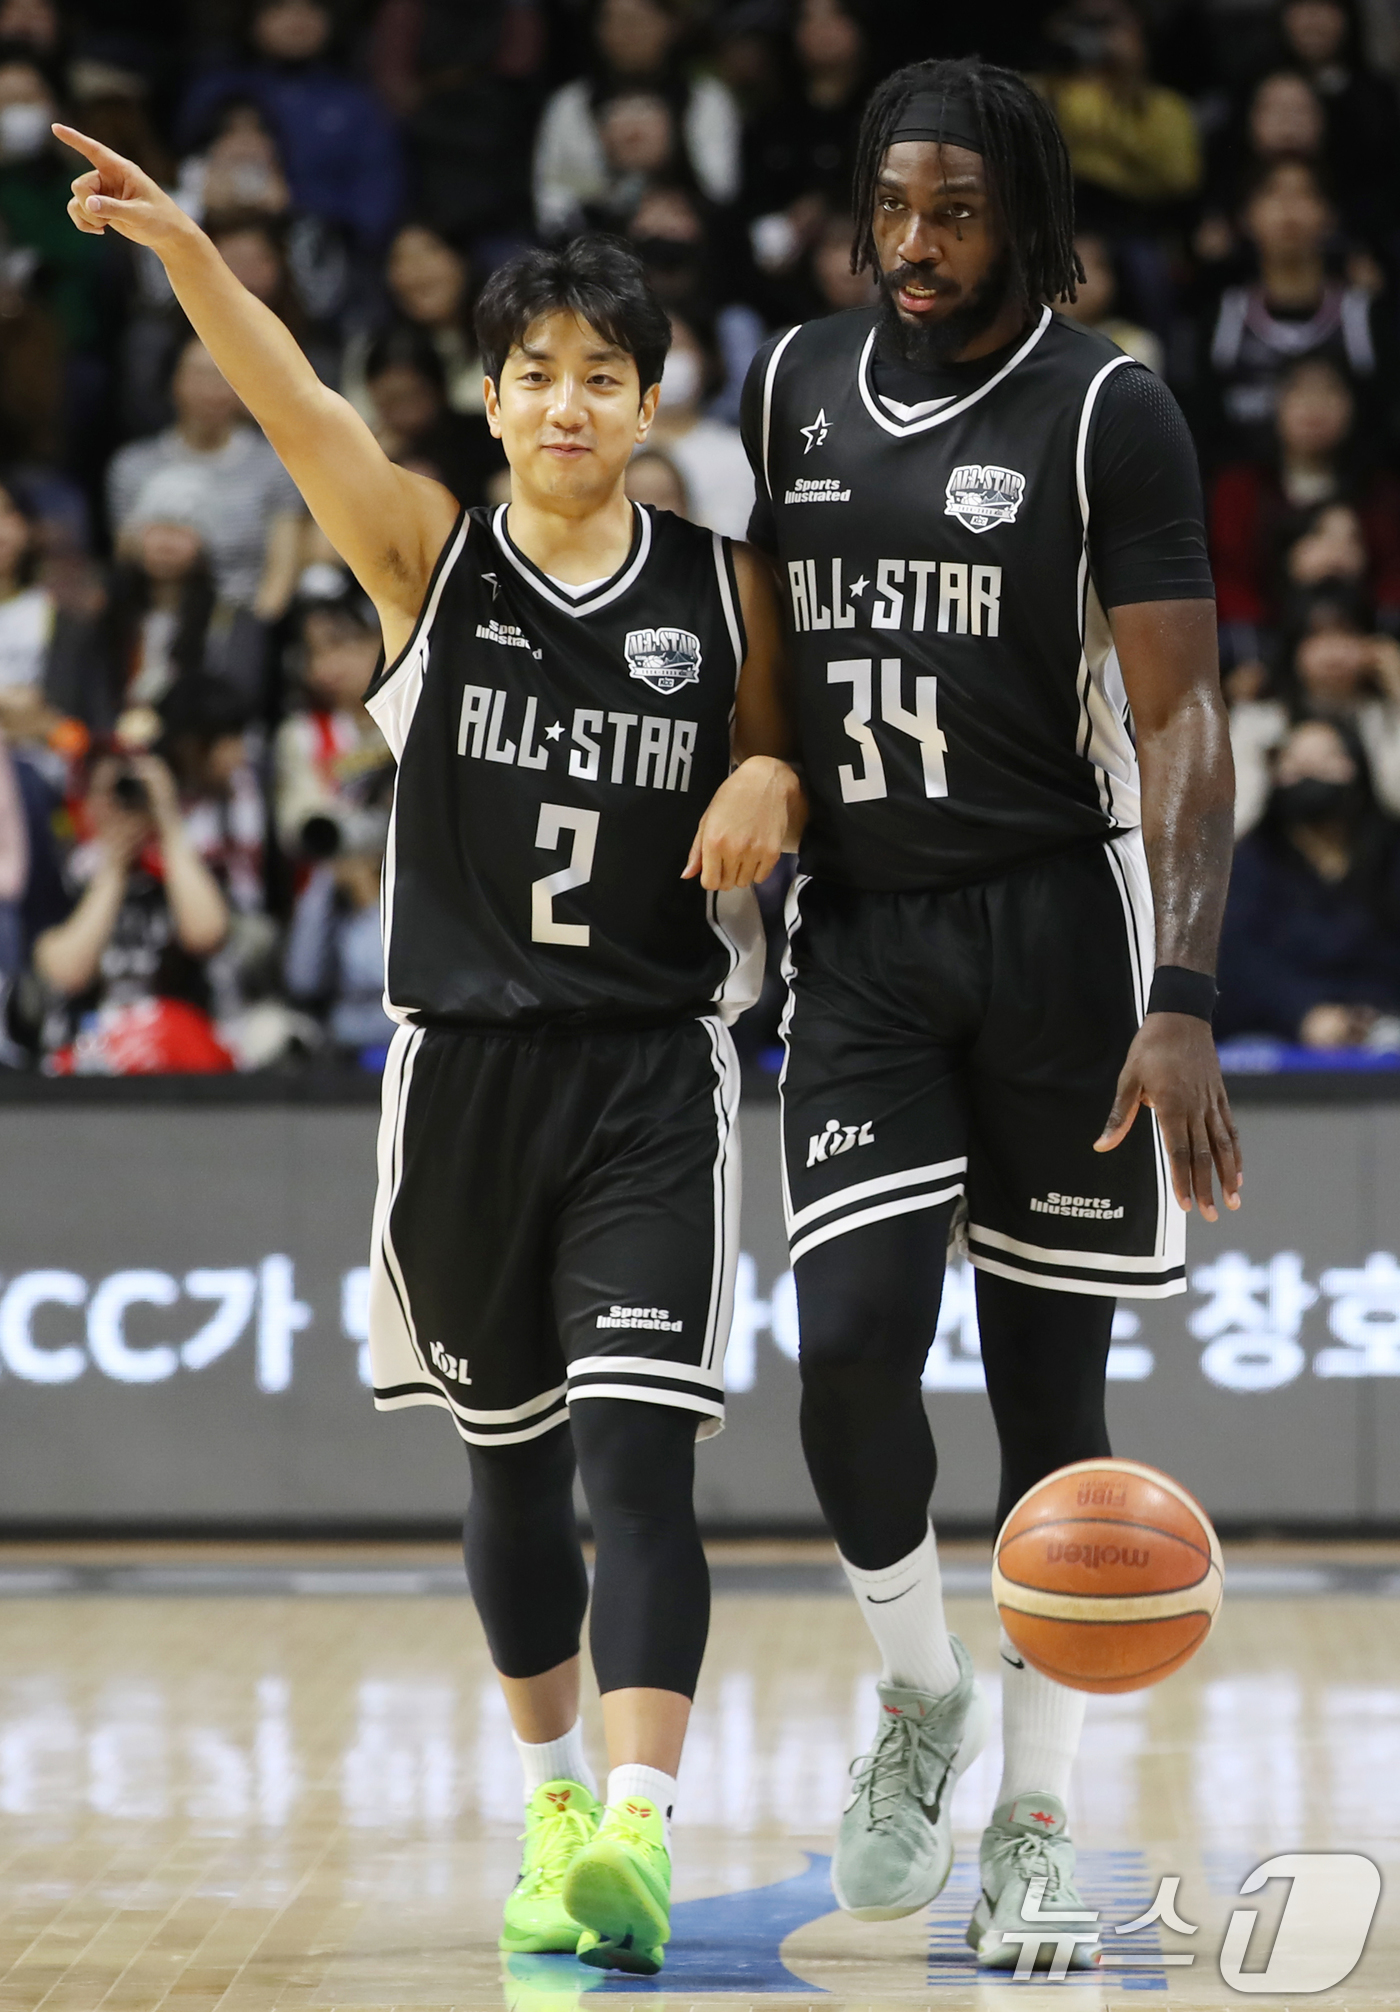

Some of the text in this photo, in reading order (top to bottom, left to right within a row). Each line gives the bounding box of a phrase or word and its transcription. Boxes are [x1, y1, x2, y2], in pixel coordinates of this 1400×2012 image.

[784, 489, 852, 505] Illustrated
[794, 478, 841, 493] Sports
[950, 468, 1020, 499] ALL STAR
[788, 558, 1003, 637] ALL STAR
[629, 631, 698, 660] ALL STAR
[457, 684, 698, 793] ALL STAR
[826, 658, 949, 804] 34
[531, 802, 601, 947] 2
[806, 1119, 875, 1168] KBL
[1030, 1198, 1125, 1220] Illustrated
[1047, 1192, 1112, 1209] Sports
[596, 1315, 683, 1333] Illustrated
[609, 1305, 670, 1320] Sports
[429, 1341, 472, 1385] KBL
[1077, 1488, 1127, 1506] FIBA
[1046, 1542, 1150, 1569] molten
